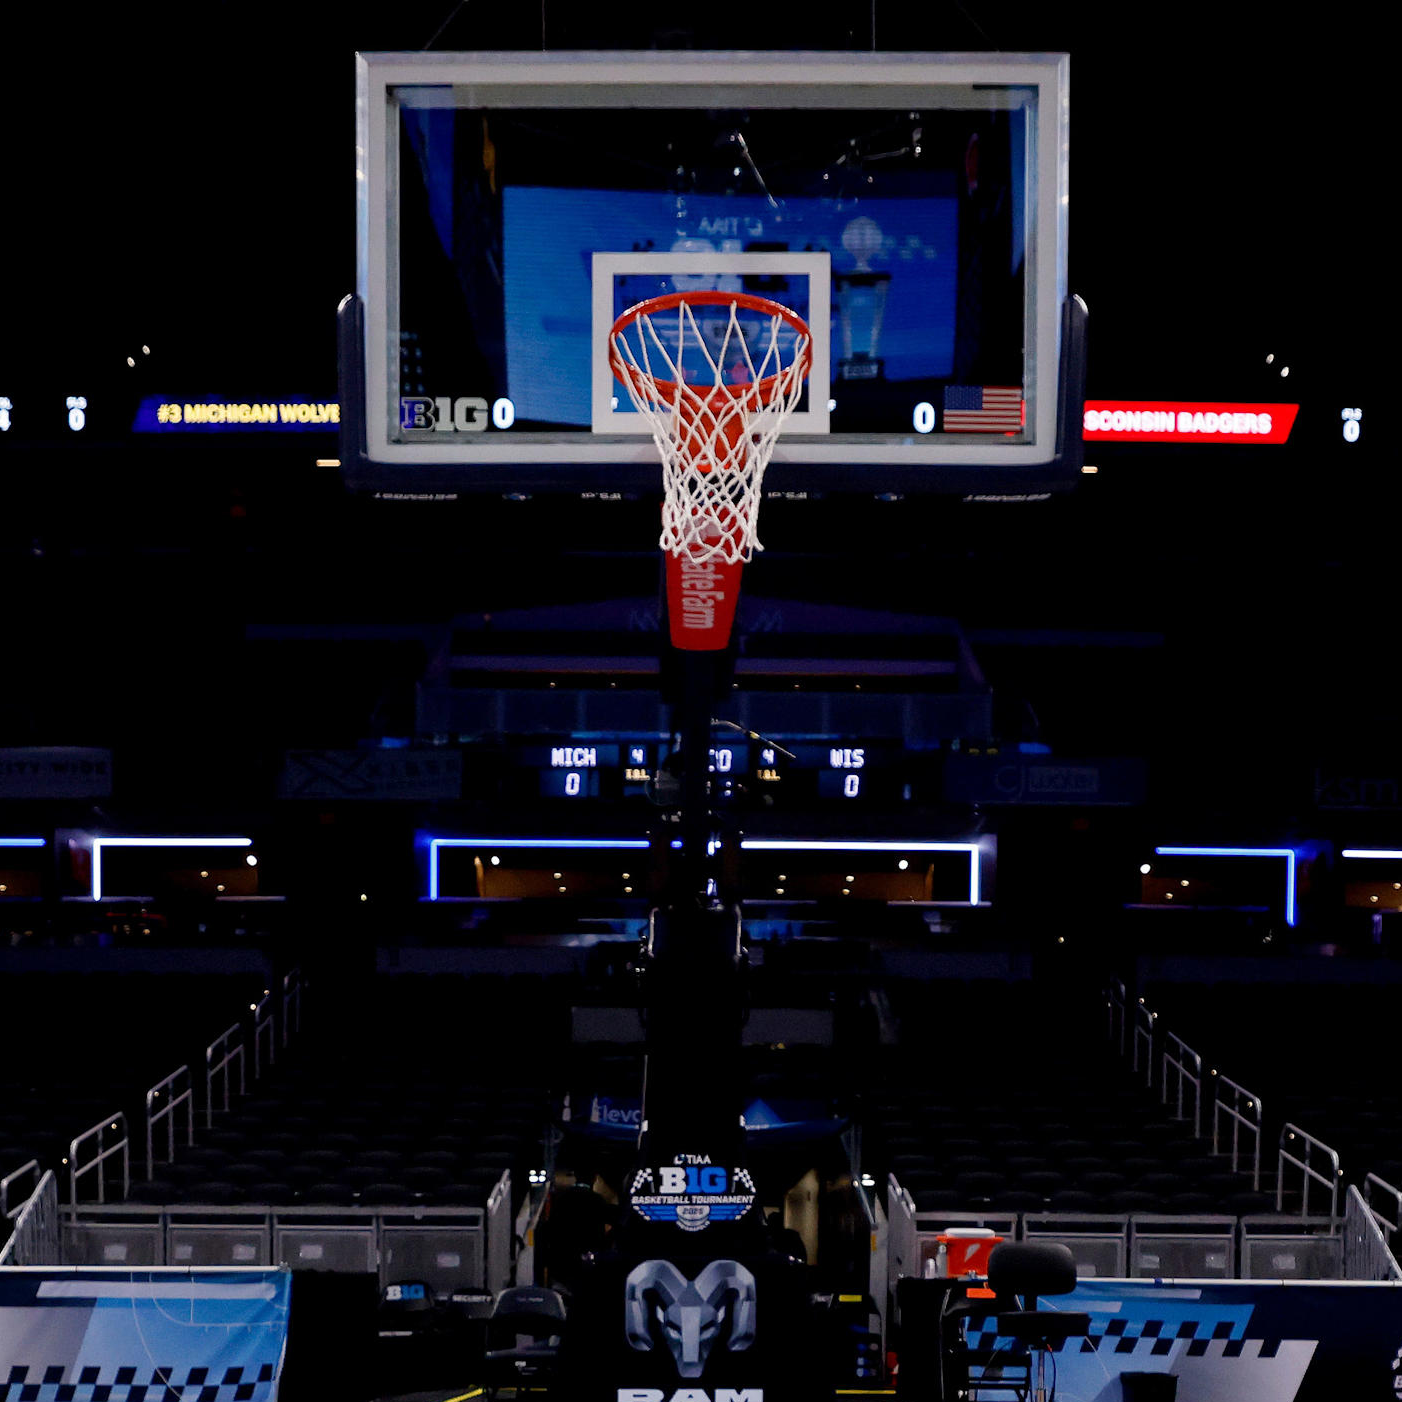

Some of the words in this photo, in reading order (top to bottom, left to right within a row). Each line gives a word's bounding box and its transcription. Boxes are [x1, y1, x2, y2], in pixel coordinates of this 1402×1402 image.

[68, 408, 85, 431] 0
[157, 404, 182, 423] #3
[184, 404, 278, 423] MICHIGAN
[492, 398, 515, 429] 0
[913, 402, 935, 434] 0
[1177, 411, 1272, 435] BADGERS
[1343, 419, 1360, 442] 0
[551, 748, 597, 768] MICH
[830, 748, 865, 768] WIS
[565, 773, 581, 796] 0
[844, 774, 860, 798] 0
[631, 1195, 690, 1205] BASKETBALL
[691, 1195, 755, 1205] TOURNAMENT
